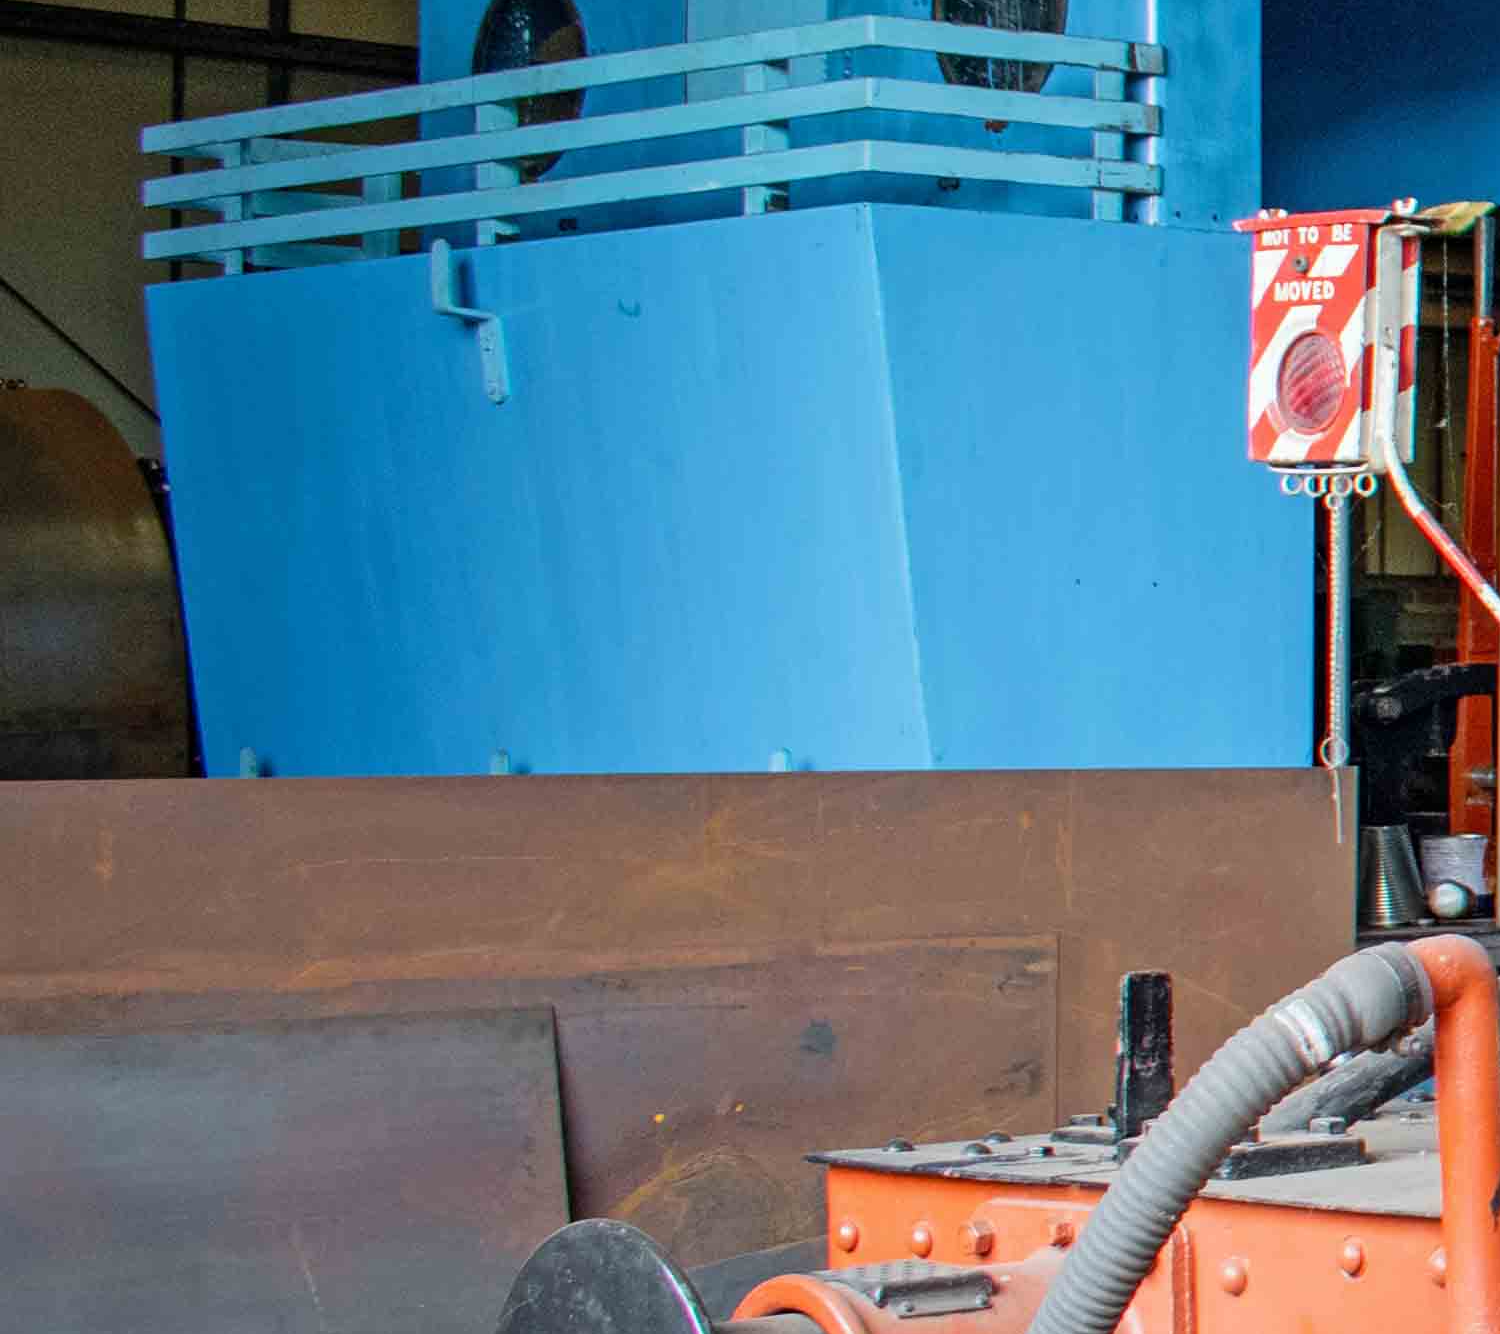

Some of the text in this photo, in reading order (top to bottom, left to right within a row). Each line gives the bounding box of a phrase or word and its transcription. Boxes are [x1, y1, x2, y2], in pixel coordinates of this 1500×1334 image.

[1261, 223, 1353, 246] NOT TO BE
[1274, 281, 1335, 302] MOVED
